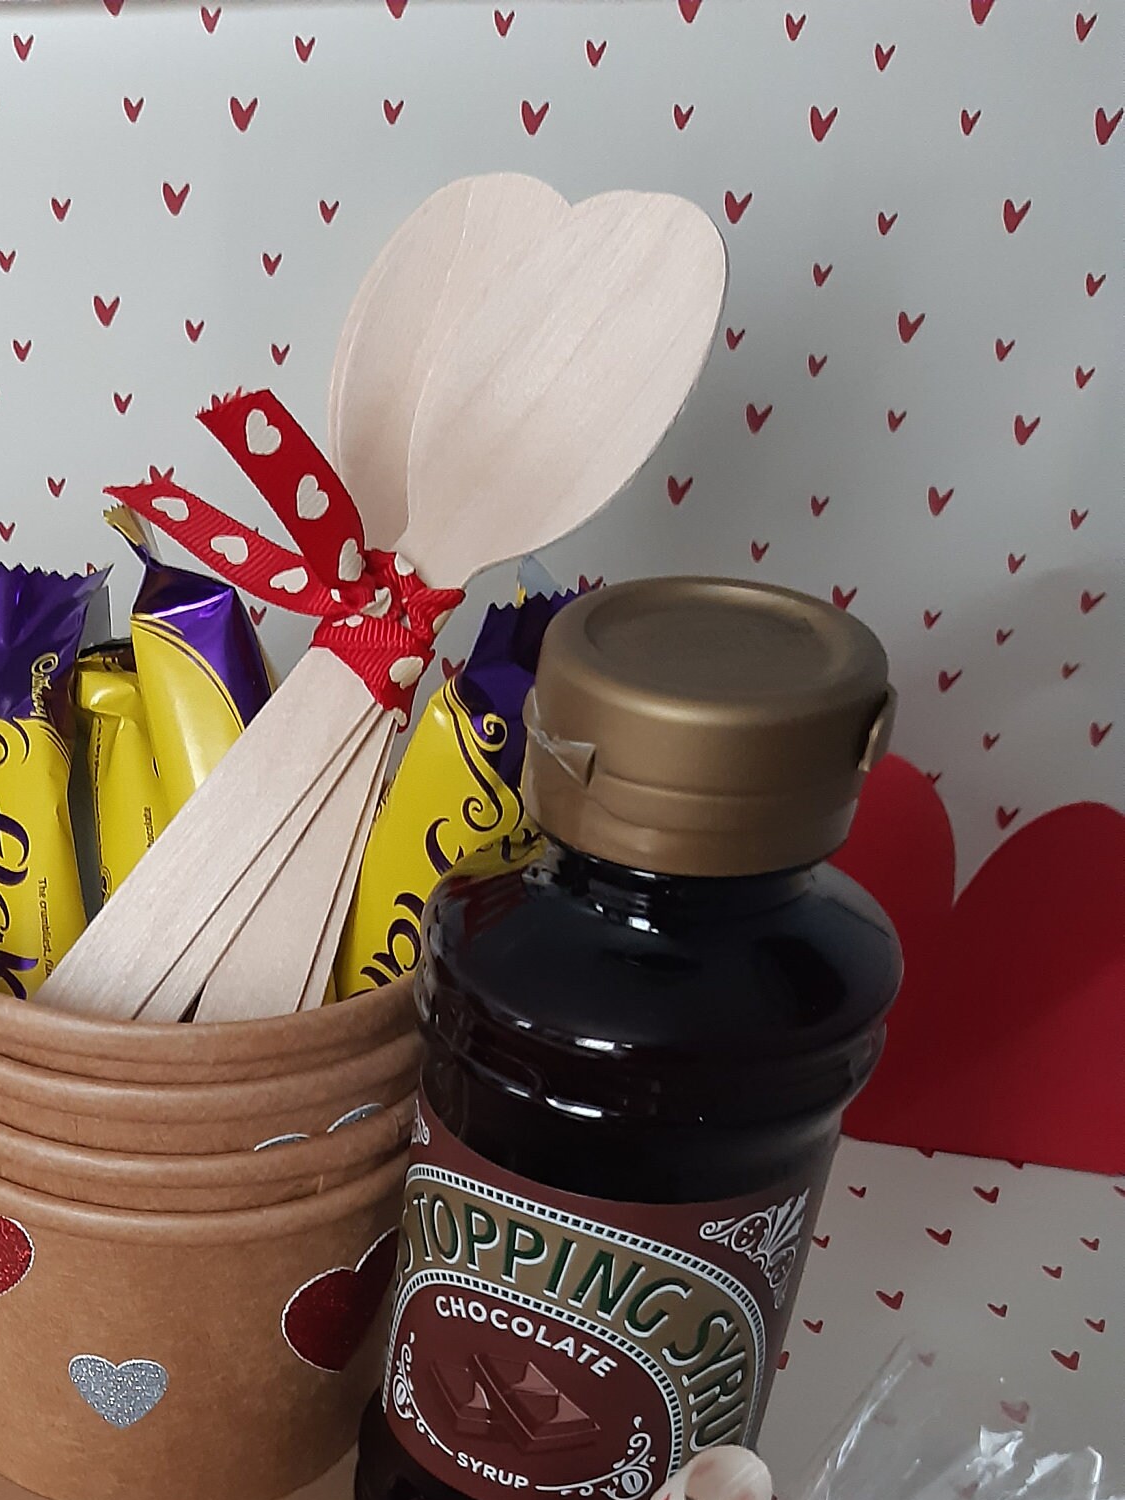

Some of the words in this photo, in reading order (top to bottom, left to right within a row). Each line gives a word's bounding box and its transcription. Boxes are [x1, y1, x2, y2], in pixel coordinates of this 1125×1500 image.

[413, 1190, 692, 1338] TOPPING
[661, 1310, 747, 1453] SYRU
[435, 1294, 618, 1378] CHOCOLATE
[456, 1451, 530, 1490] SYRUP
